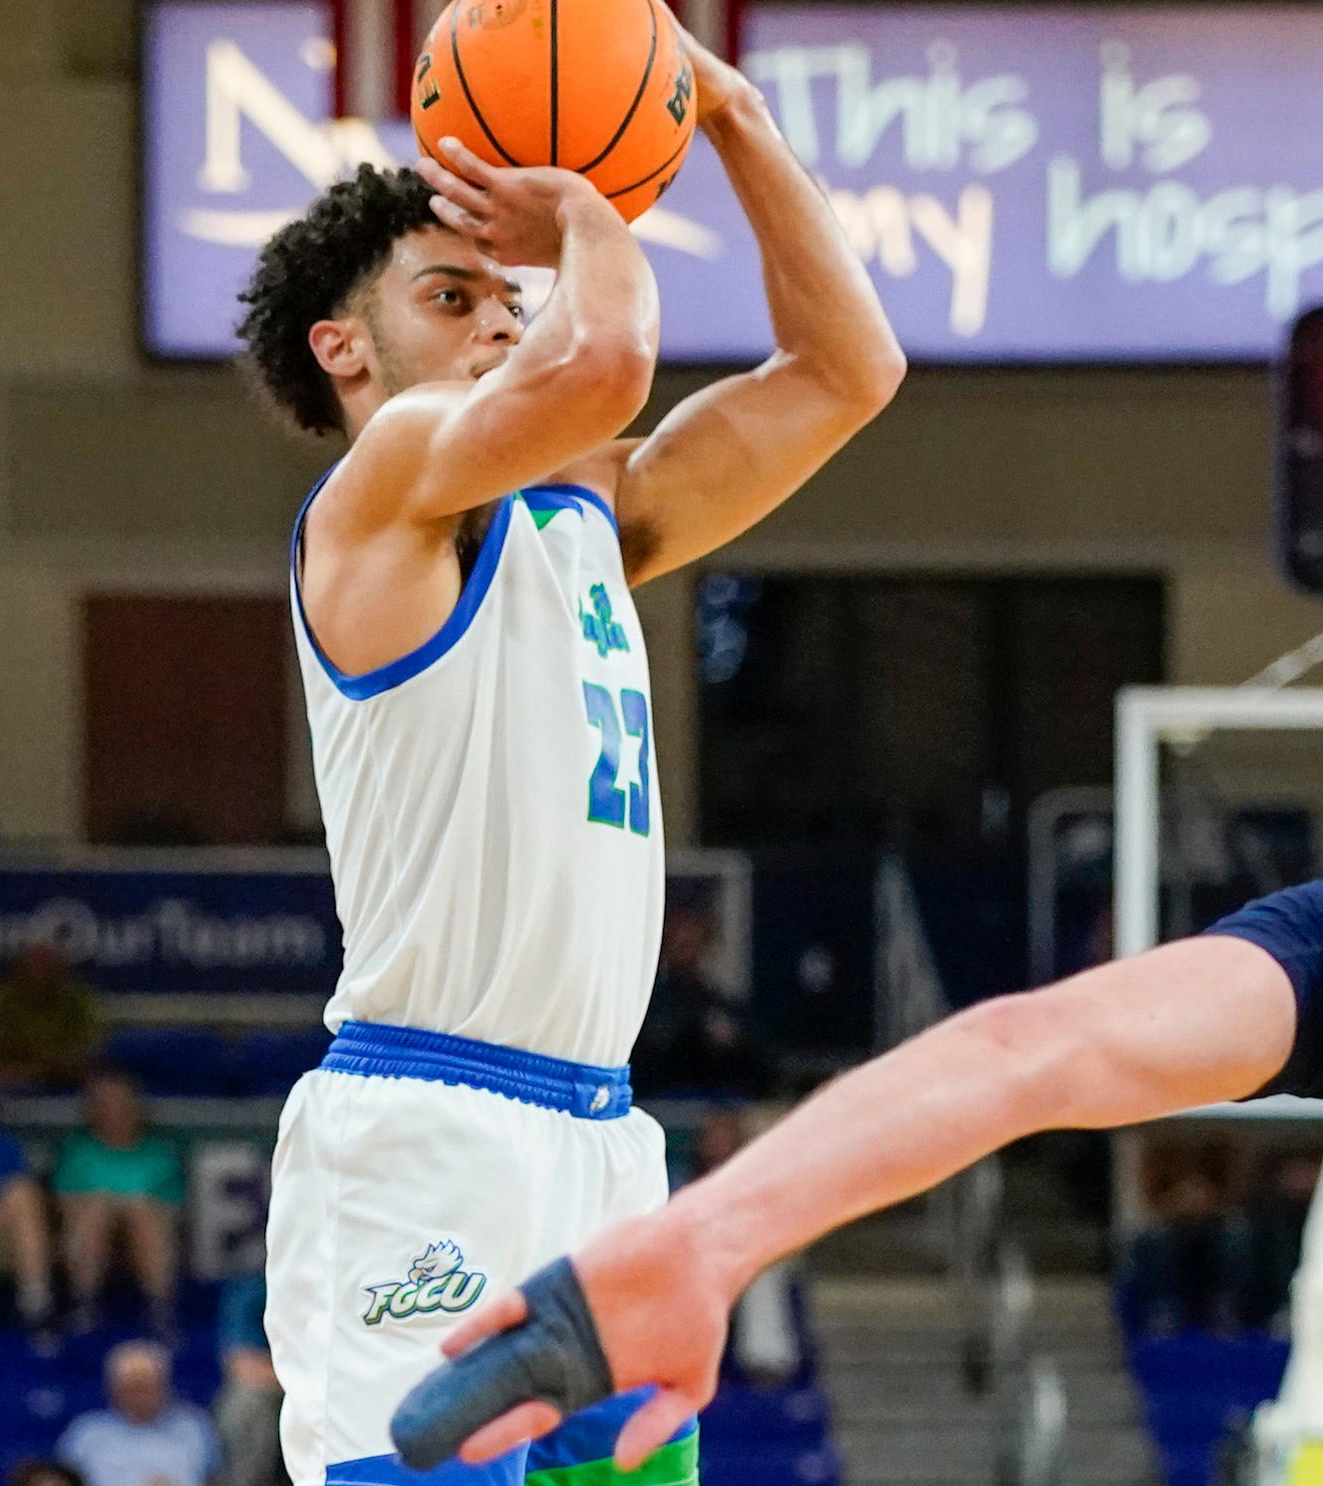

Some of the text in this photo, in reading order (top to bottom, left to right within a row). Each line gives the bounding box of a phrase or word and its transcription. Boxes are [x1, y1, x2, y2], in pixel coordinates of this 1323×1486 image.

[743, 42, 1039, 174] This
[1097, 40, 1213, 174] is
[582, 680, 650, 838] 23
[362, 1271, 487, 1326] FGCU
